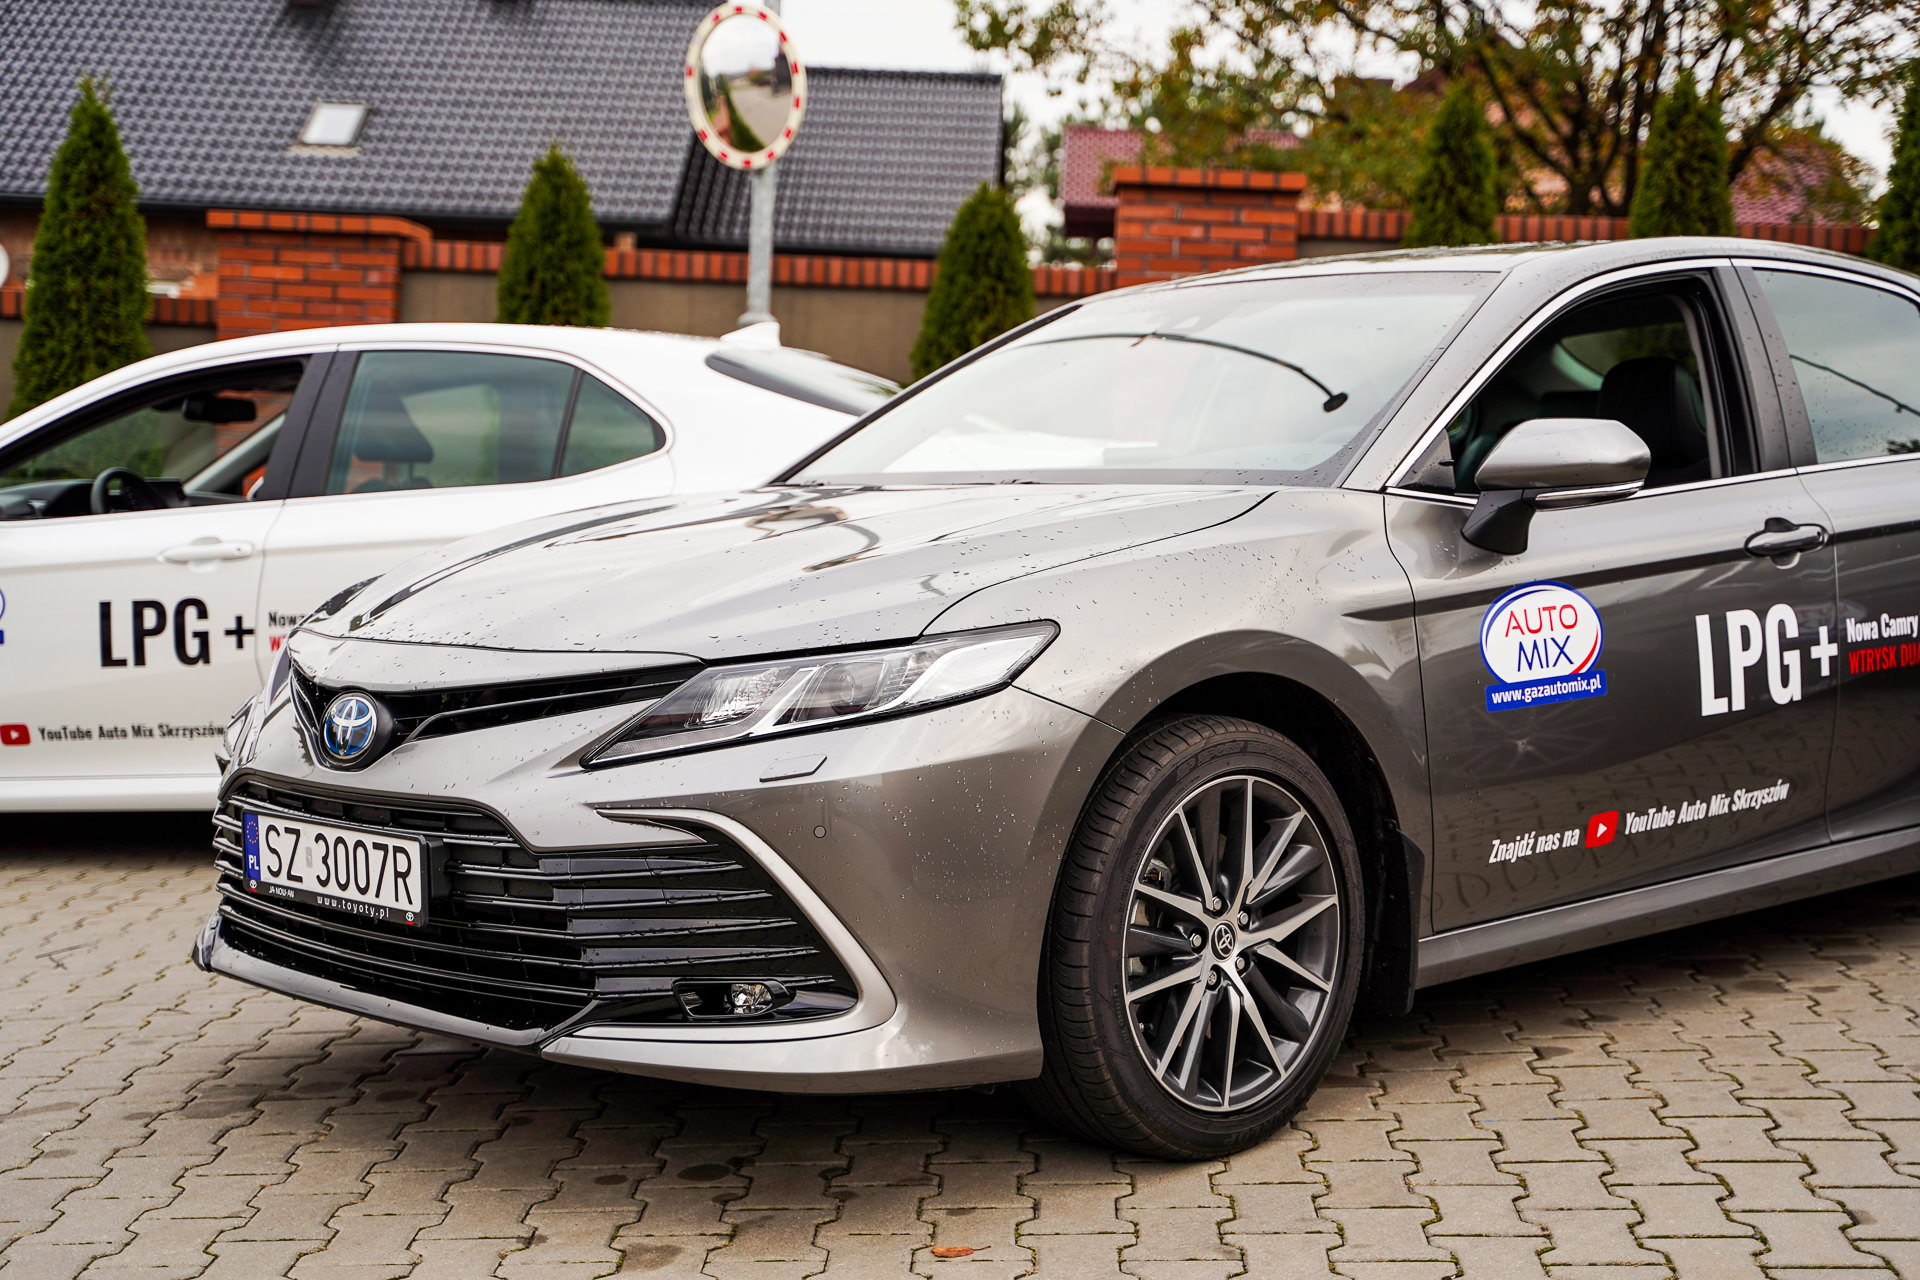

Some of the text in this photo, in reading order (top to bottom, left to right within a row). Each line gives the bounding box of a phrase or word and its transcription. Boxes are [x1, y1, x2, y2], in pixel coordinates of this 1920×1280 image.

[1504, 603, 1578, 638] AUTO
[1846, 612, 1919, 643] Nowa Camry
[1517, 635, 1575, 672] MIX
[1848, 645, 1897, 675] WTRYSK
[1491, 674, 1602, 704] www.gazautomix.pl
[38, 725, 93, 742] YouTube
[98, 723, 128, 740] Auto
[131, 723, 154, 739] Mix
[1488, 778, 1790, 864] Znajdź nas na YouTube Auto Mix Skrzyszów
[248, 854, 260, 871] PL
[265, 823, 413, 906] SZ 3007R
[316, 895, 390, 919] www.toyoty.pl
